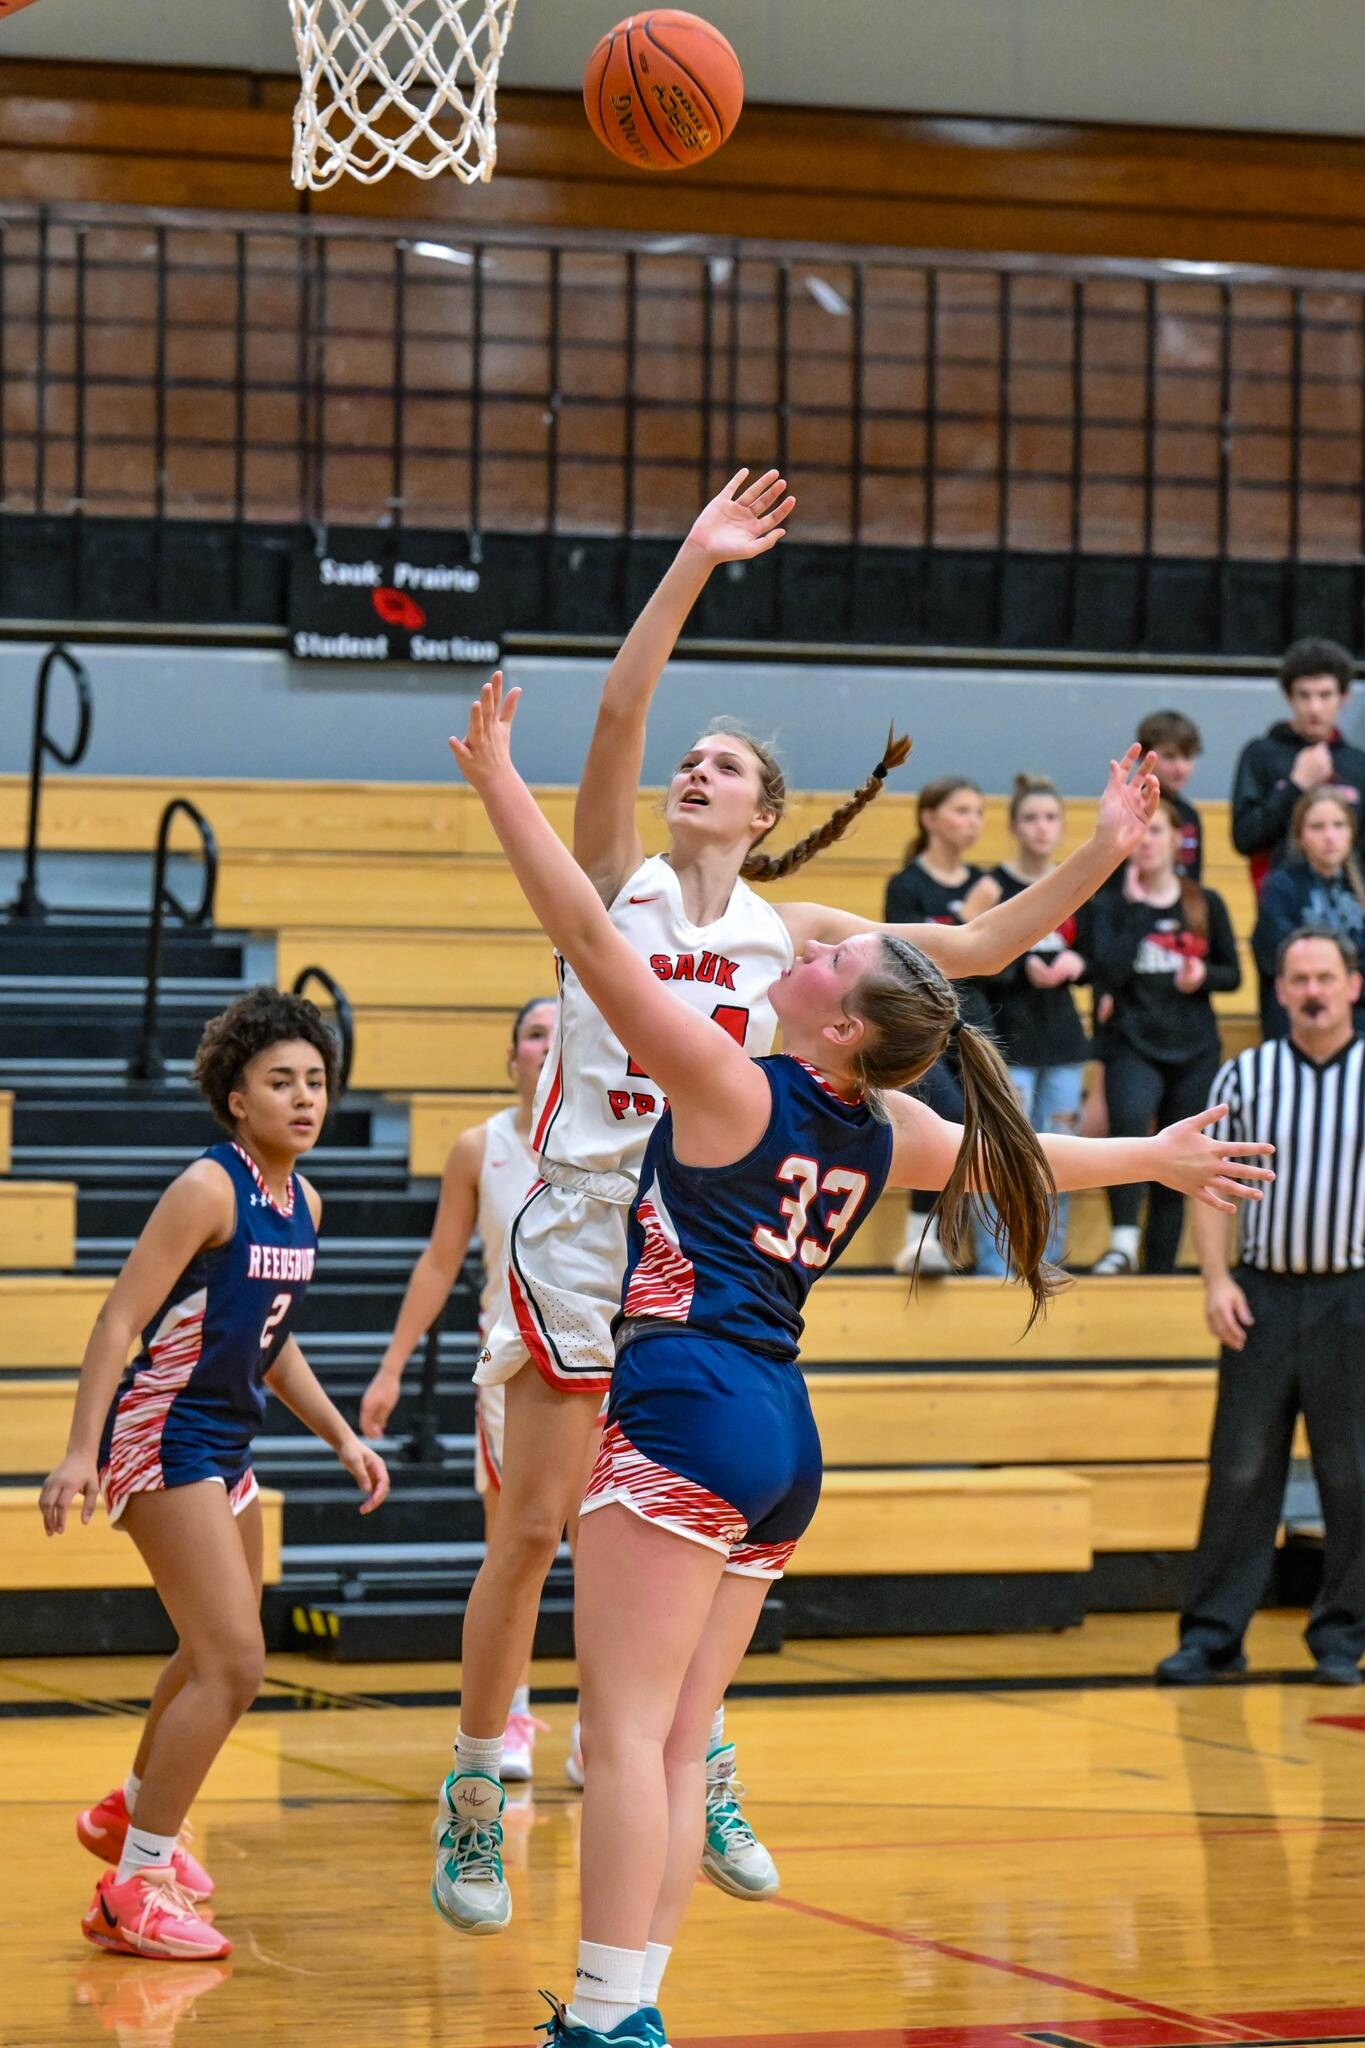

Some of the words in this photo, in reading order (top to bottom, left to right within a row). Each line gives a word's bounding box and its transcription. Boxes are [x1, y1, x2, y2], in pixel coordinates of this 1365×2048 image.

[319, 558, 382, 586] Sauk
[393, 561, 480, 593] Prairie
[294, 631, 389, 659] Student
[410, 634, 499, 662] Section
[650, 950, 740, 991] SAUK
[607, 1090, 671, 1120] PR
[752, 1153, 869, 1268] 33
[259, 1292, 293, 1350] 2
